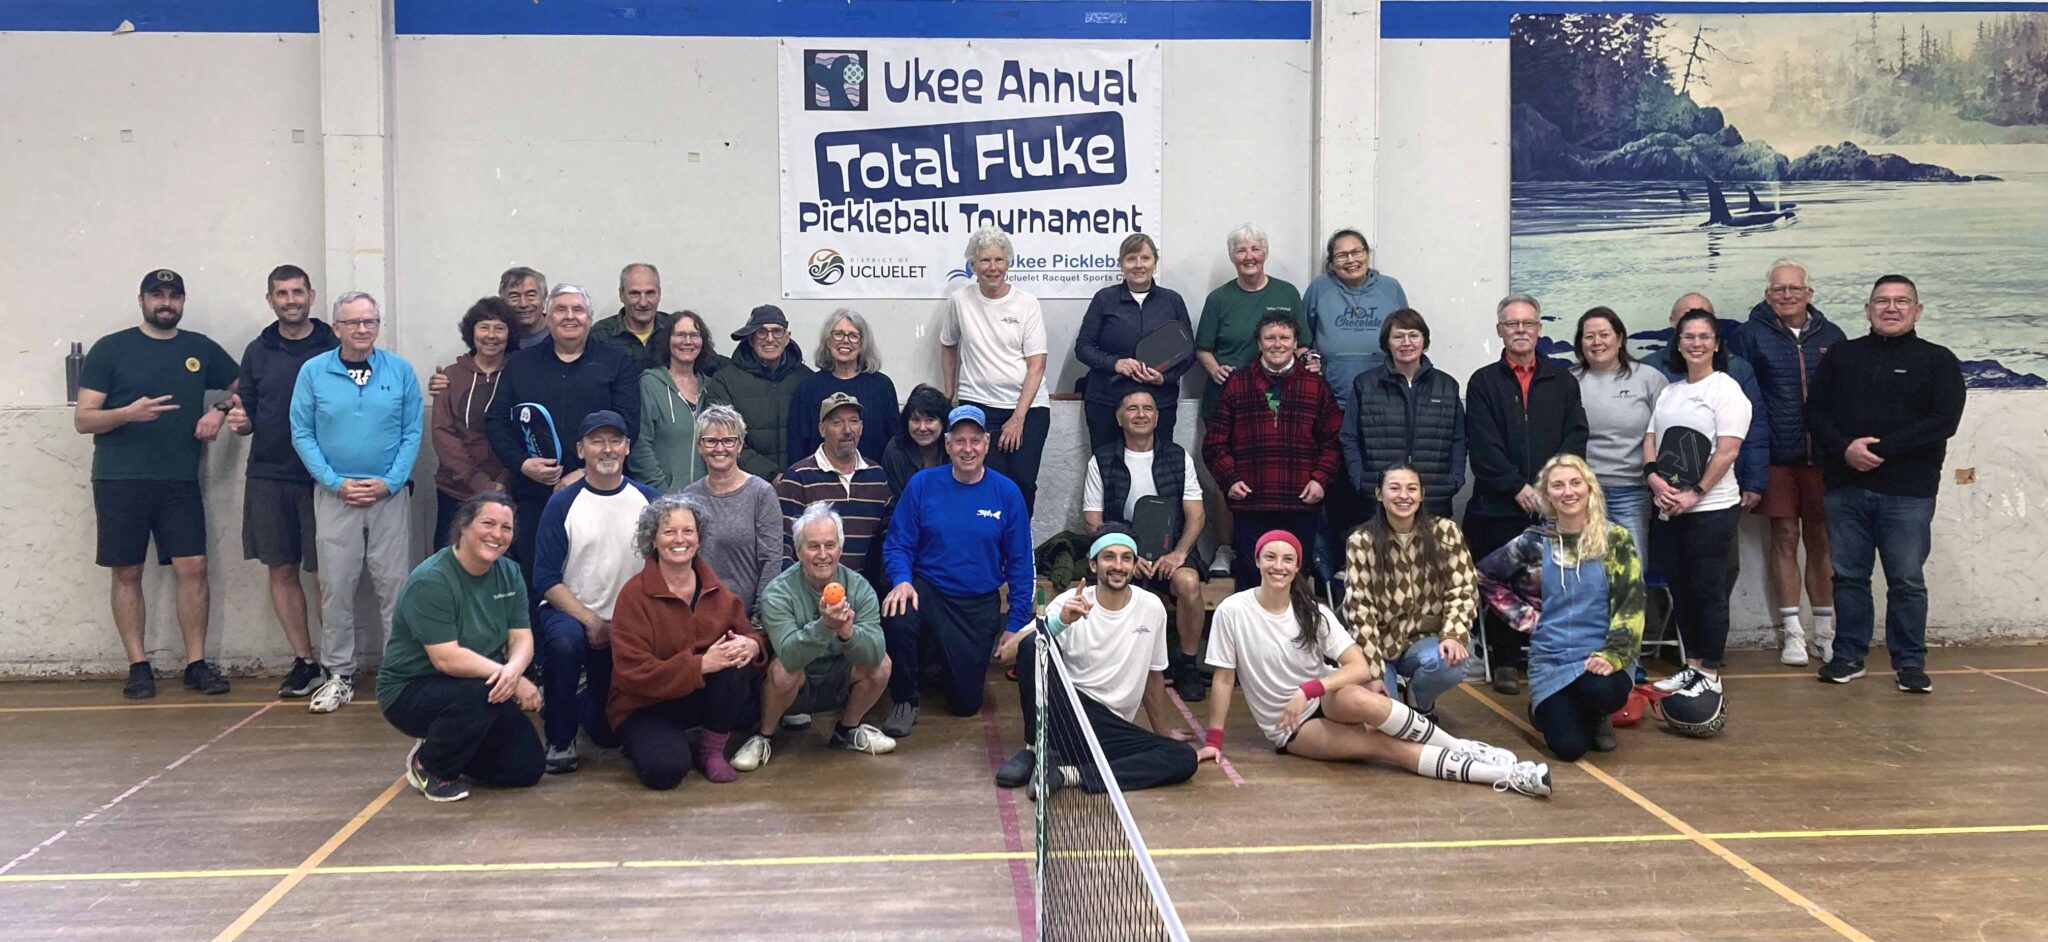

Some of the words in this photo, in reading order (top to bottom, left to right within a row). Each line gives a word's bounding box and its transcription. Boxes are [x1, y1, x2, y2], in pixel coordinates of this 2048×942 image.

[884, 57, 983, 104] Ukee
[998, 59, 1137, 106] Annual
[826, 134, 960, 192] Total
[975, 125, 1115, 180] Fluke
[800, 201, 949, 235] Pickleball
[959, 203, 1143, 235] Tournament
[850, 265, 927, 278] UCLUELET
[1042, 274, 1080, 282] Racquet
[1082, 274, 1113, 282] Sports
